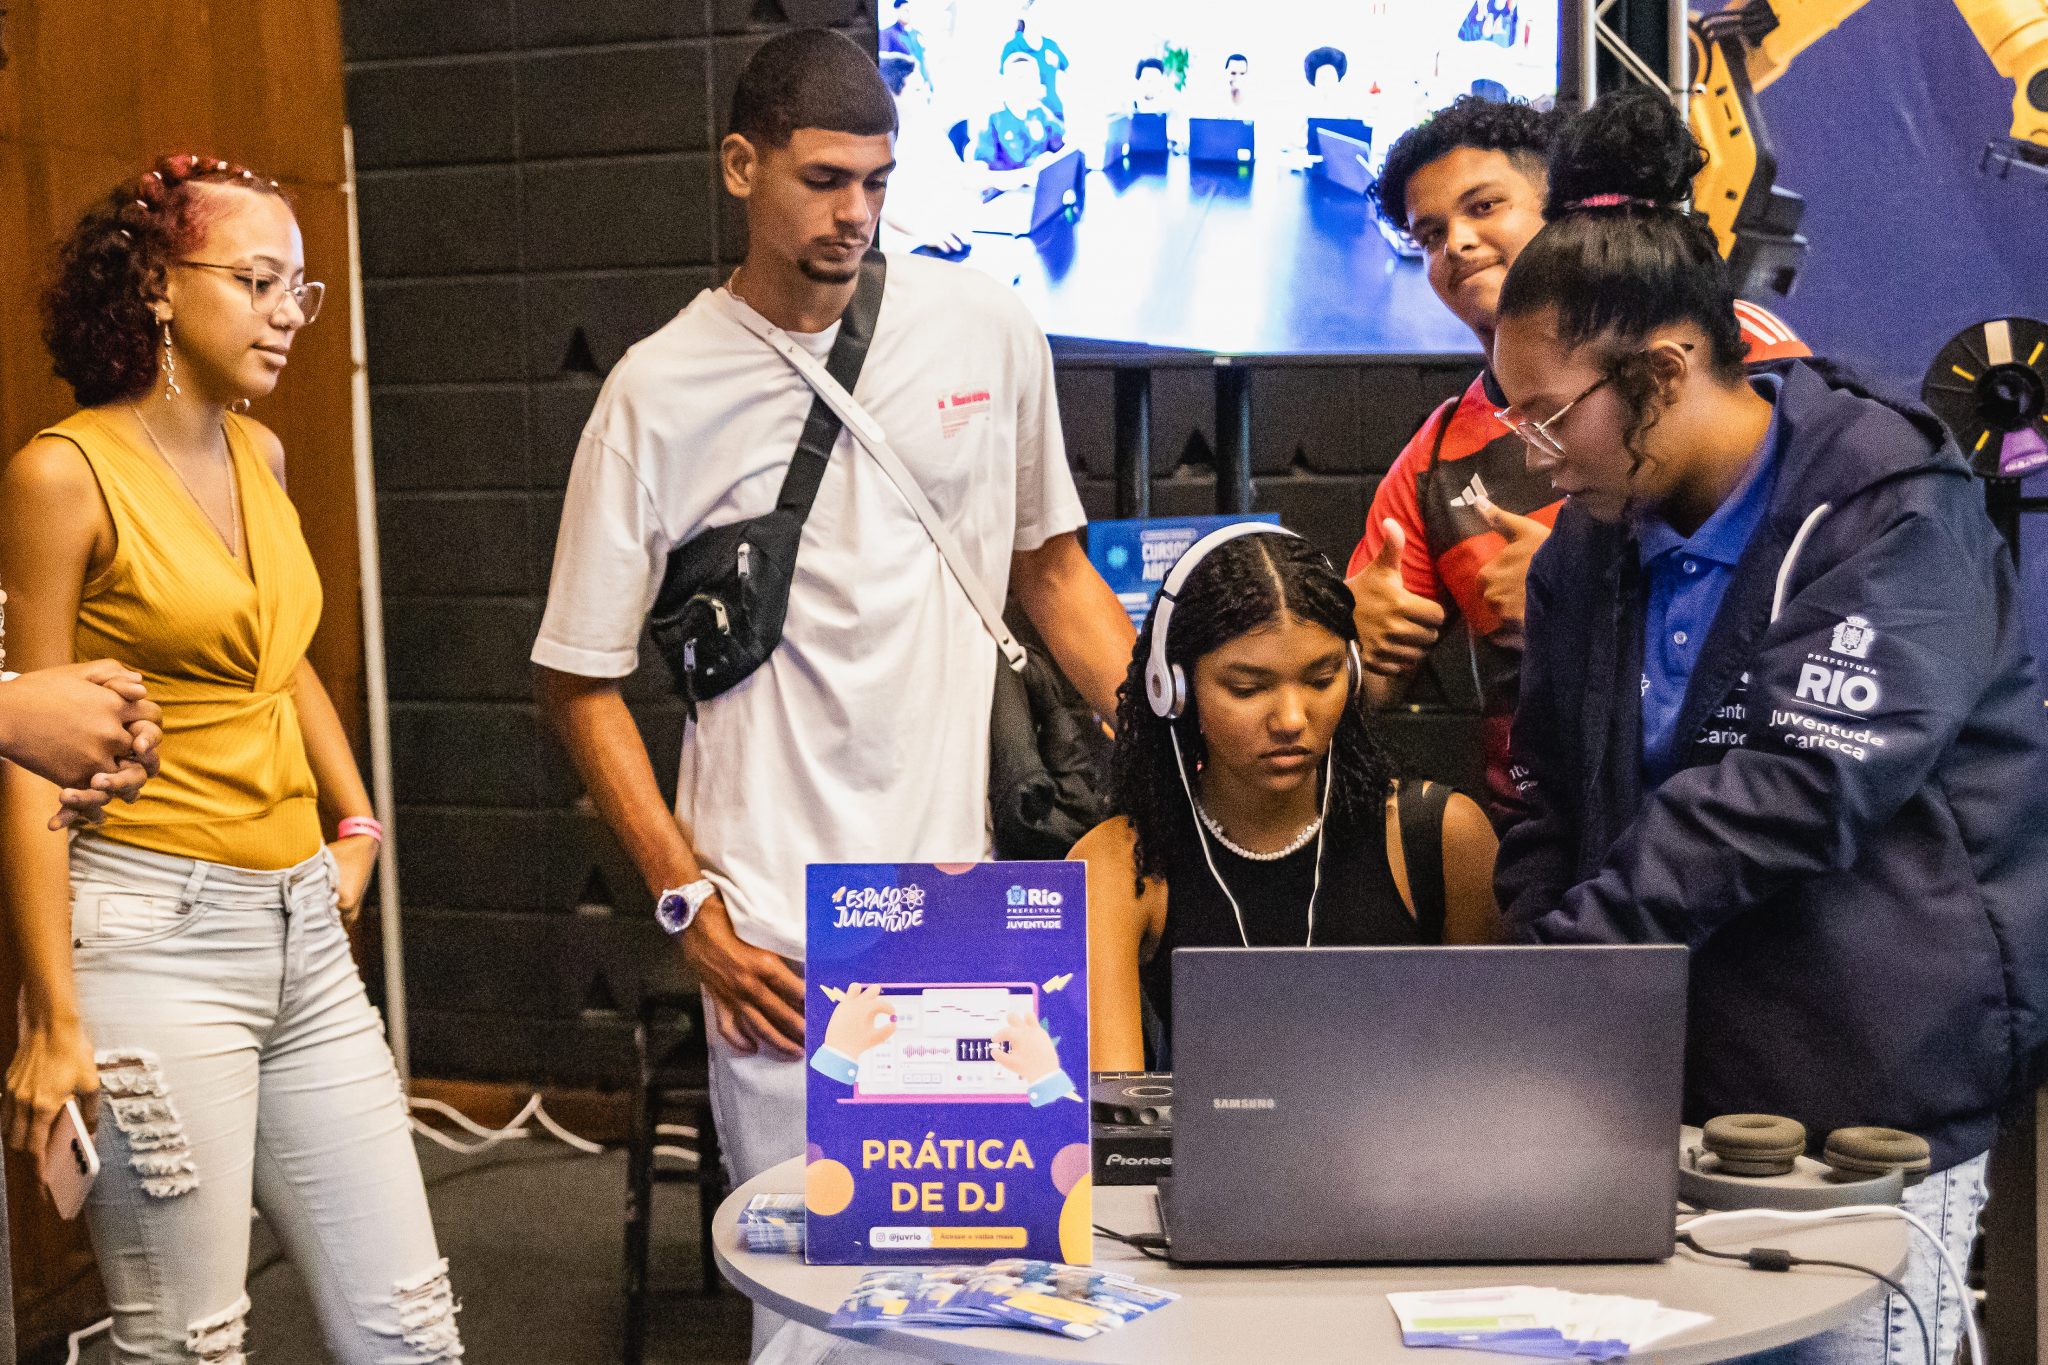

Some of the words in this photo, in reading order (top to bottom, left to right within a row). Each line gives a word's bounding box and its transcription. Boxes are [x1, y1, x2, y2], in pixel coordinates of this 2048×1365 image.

[1807, 653, 1878, 675] PREFEITURA
[1795, 662, 1879, 712] RIO
[1028, 889, 1063, 906] Rio
[833, 906, 924, 932] JUVENTUDE
[1006, 921, 1062, 929] JUVENTUDE
[1213, 1098, 1276, 1109] SAMSUNG
[862, 1131, 1035, 1169] PRÁTICA
[891, 1182, 944, 1212] DE
[958, 1182, 1005, 1212] DJ
[888, 1233, 922, 1243] @juvrio
